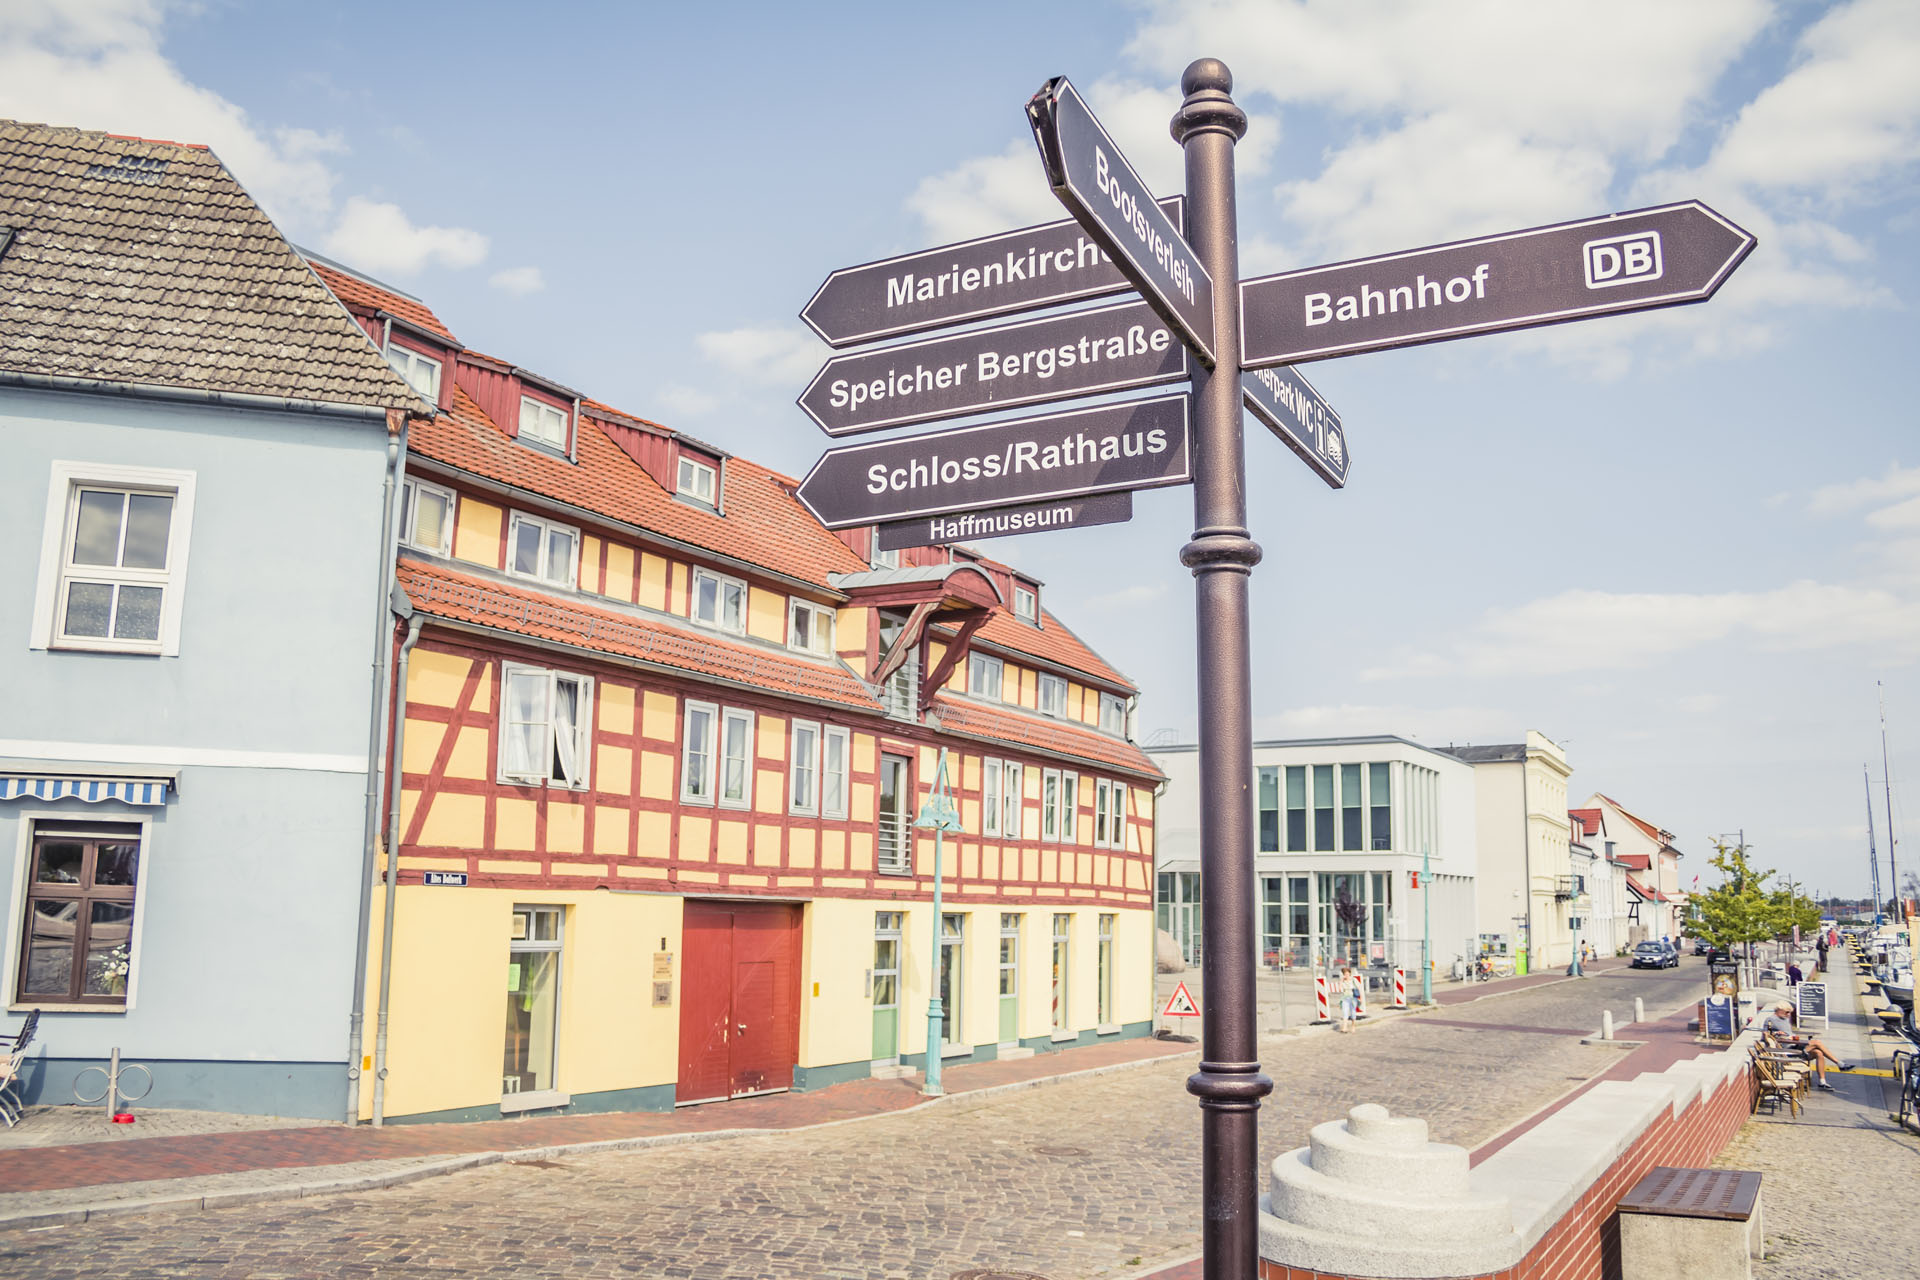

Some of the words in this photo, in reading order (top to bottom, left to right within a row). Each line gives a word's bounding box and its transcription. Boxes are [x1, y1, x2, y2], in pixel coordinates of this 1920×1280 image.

[1095, 144, 1196, 307] Bootsverleih
[886, 236, 1113, 308] Marienkirch
[1592, 241, 1653, 281] DB
[1304, 263, 1490, 327] Bahnhof
[829, 363, 968, 412] Speicher
[978, 325, 1170, 382] Bergstraße
[1295, 387, 1314, 433] WC
[866, 429, 1167, 495] Schloss/Rathaus
[930, 507, 1073, 540] Haffmuseum
